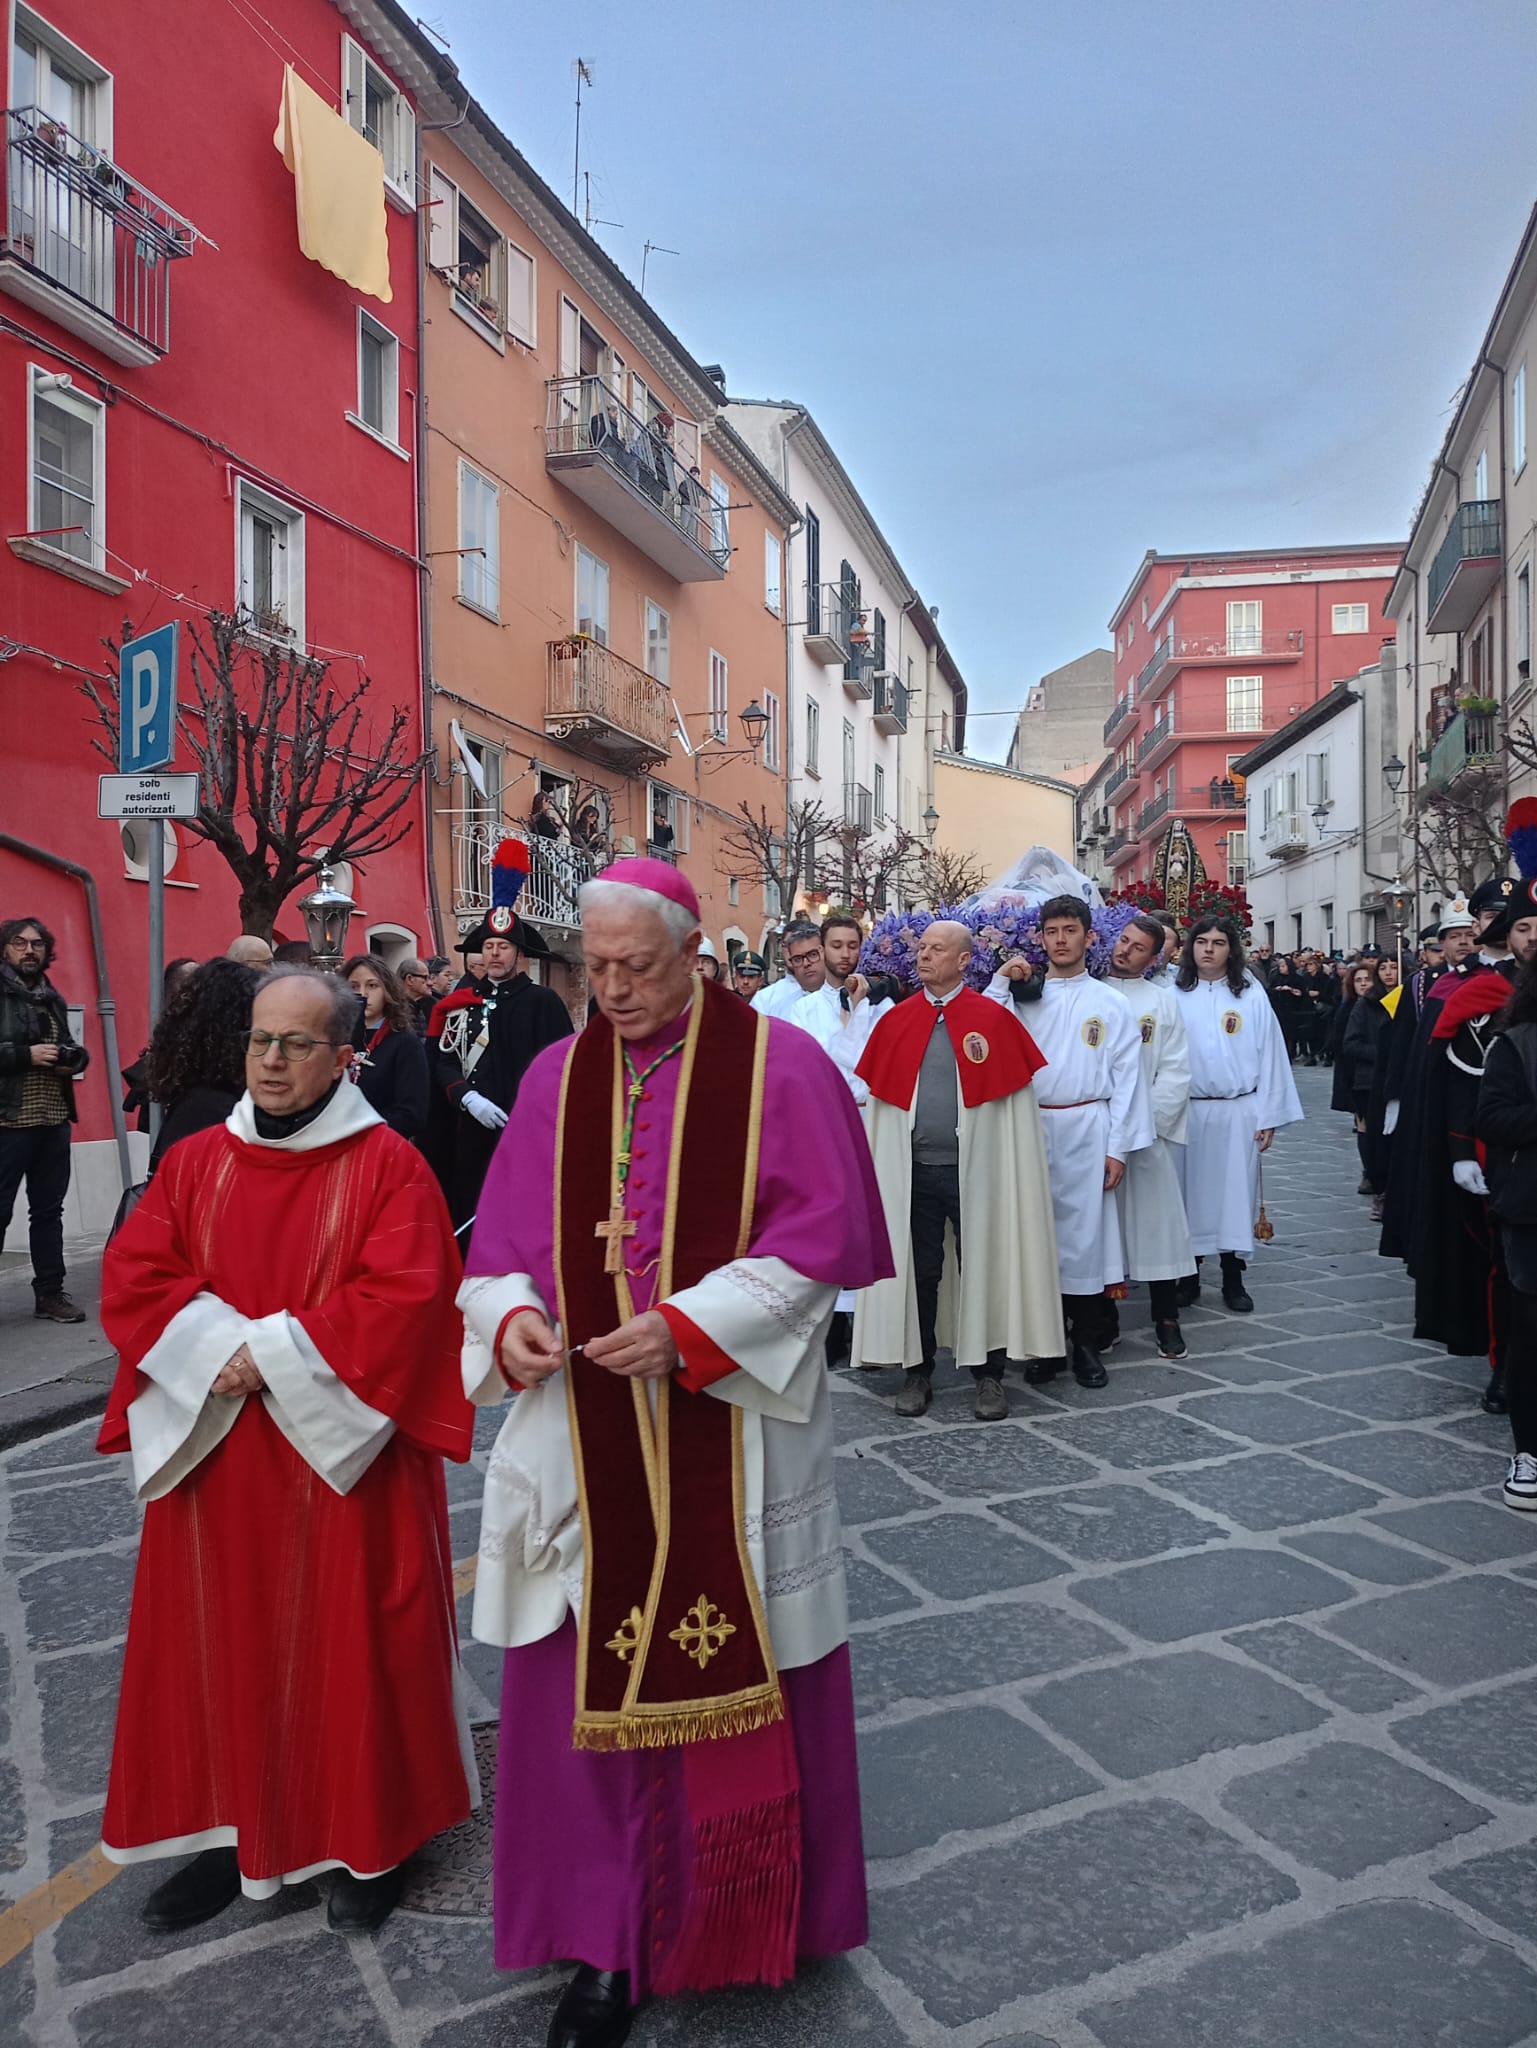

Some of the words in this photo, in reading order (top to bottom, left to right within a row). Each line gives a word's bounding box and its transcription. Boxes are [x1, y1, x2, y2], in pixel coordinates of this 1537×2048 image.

[132, 649, 159, 759] P
[139, 779, 161, 788] solo
[125, 791, 171, 801] residenti
[122, 804, 176, 814] autorizzati
